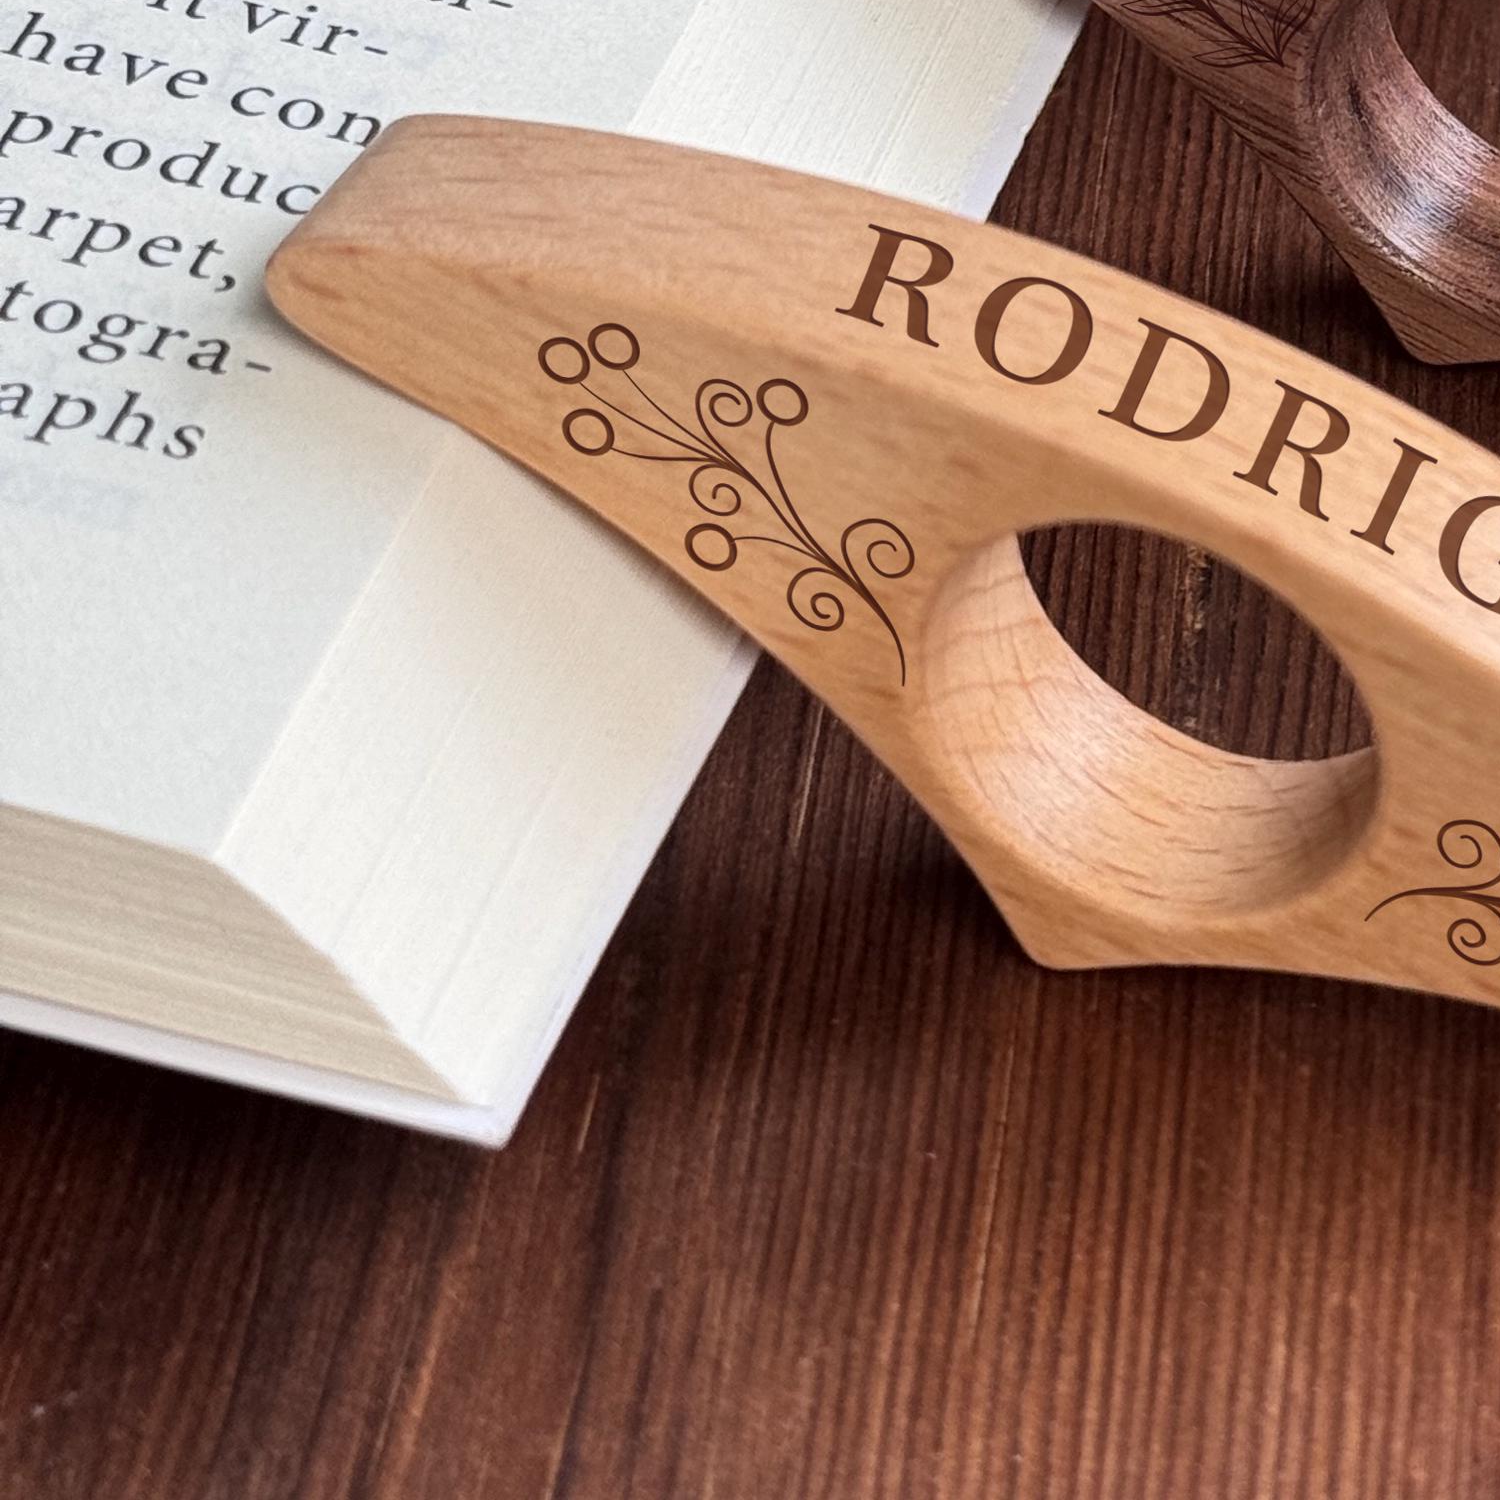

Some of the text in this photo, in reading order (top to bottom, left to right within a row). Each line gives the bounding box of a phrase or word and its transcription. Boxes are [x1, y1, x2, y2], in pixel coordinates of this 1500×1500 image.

[242, 0, 389, 57] vir-
[1, 11, 382, 148] have con
[0, 109, 321, 216] produc
[0, 195, 236, 293] arpet,
[0, 280, 273, 376] togra-
[0, 381, 206, 461] aphs
